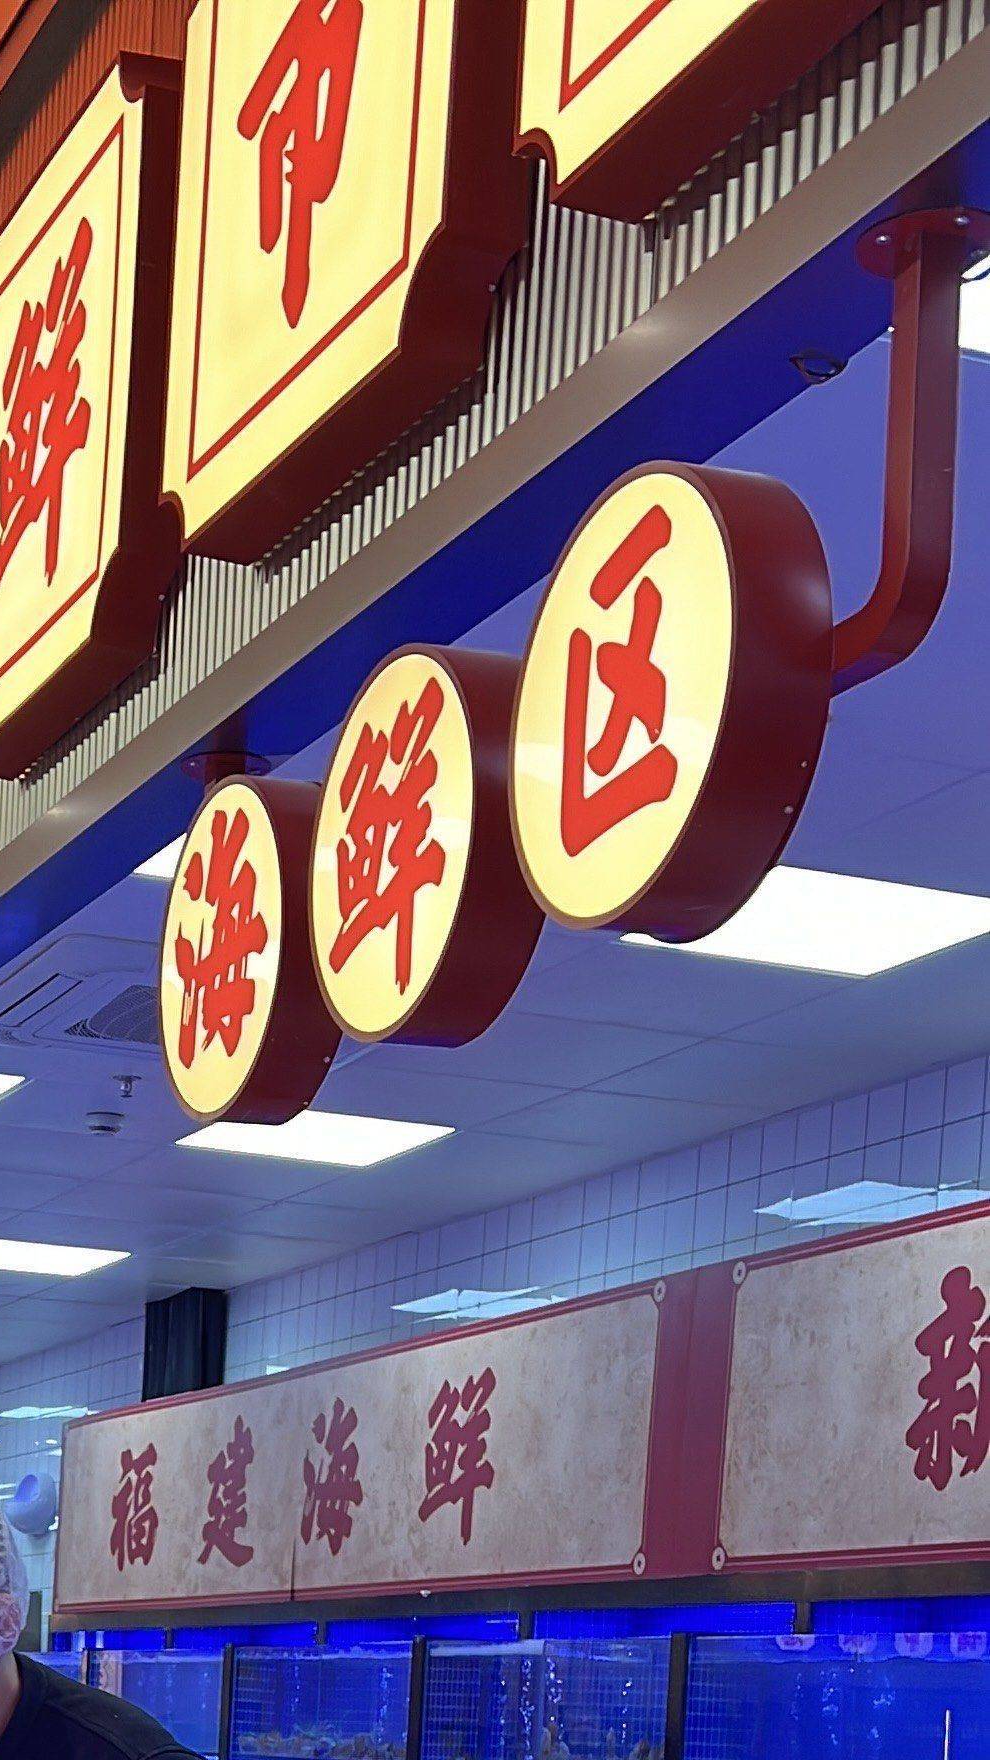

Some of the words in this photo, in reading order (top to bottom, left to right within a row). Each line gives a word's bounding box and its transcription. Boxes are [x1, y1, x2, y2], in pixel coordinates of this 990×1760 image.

[175, 503, 679, 1069] 海鲜区
[109, 1366, 497, 1572] 福建海鲜
[906, 1265, 990, 1492] 新
